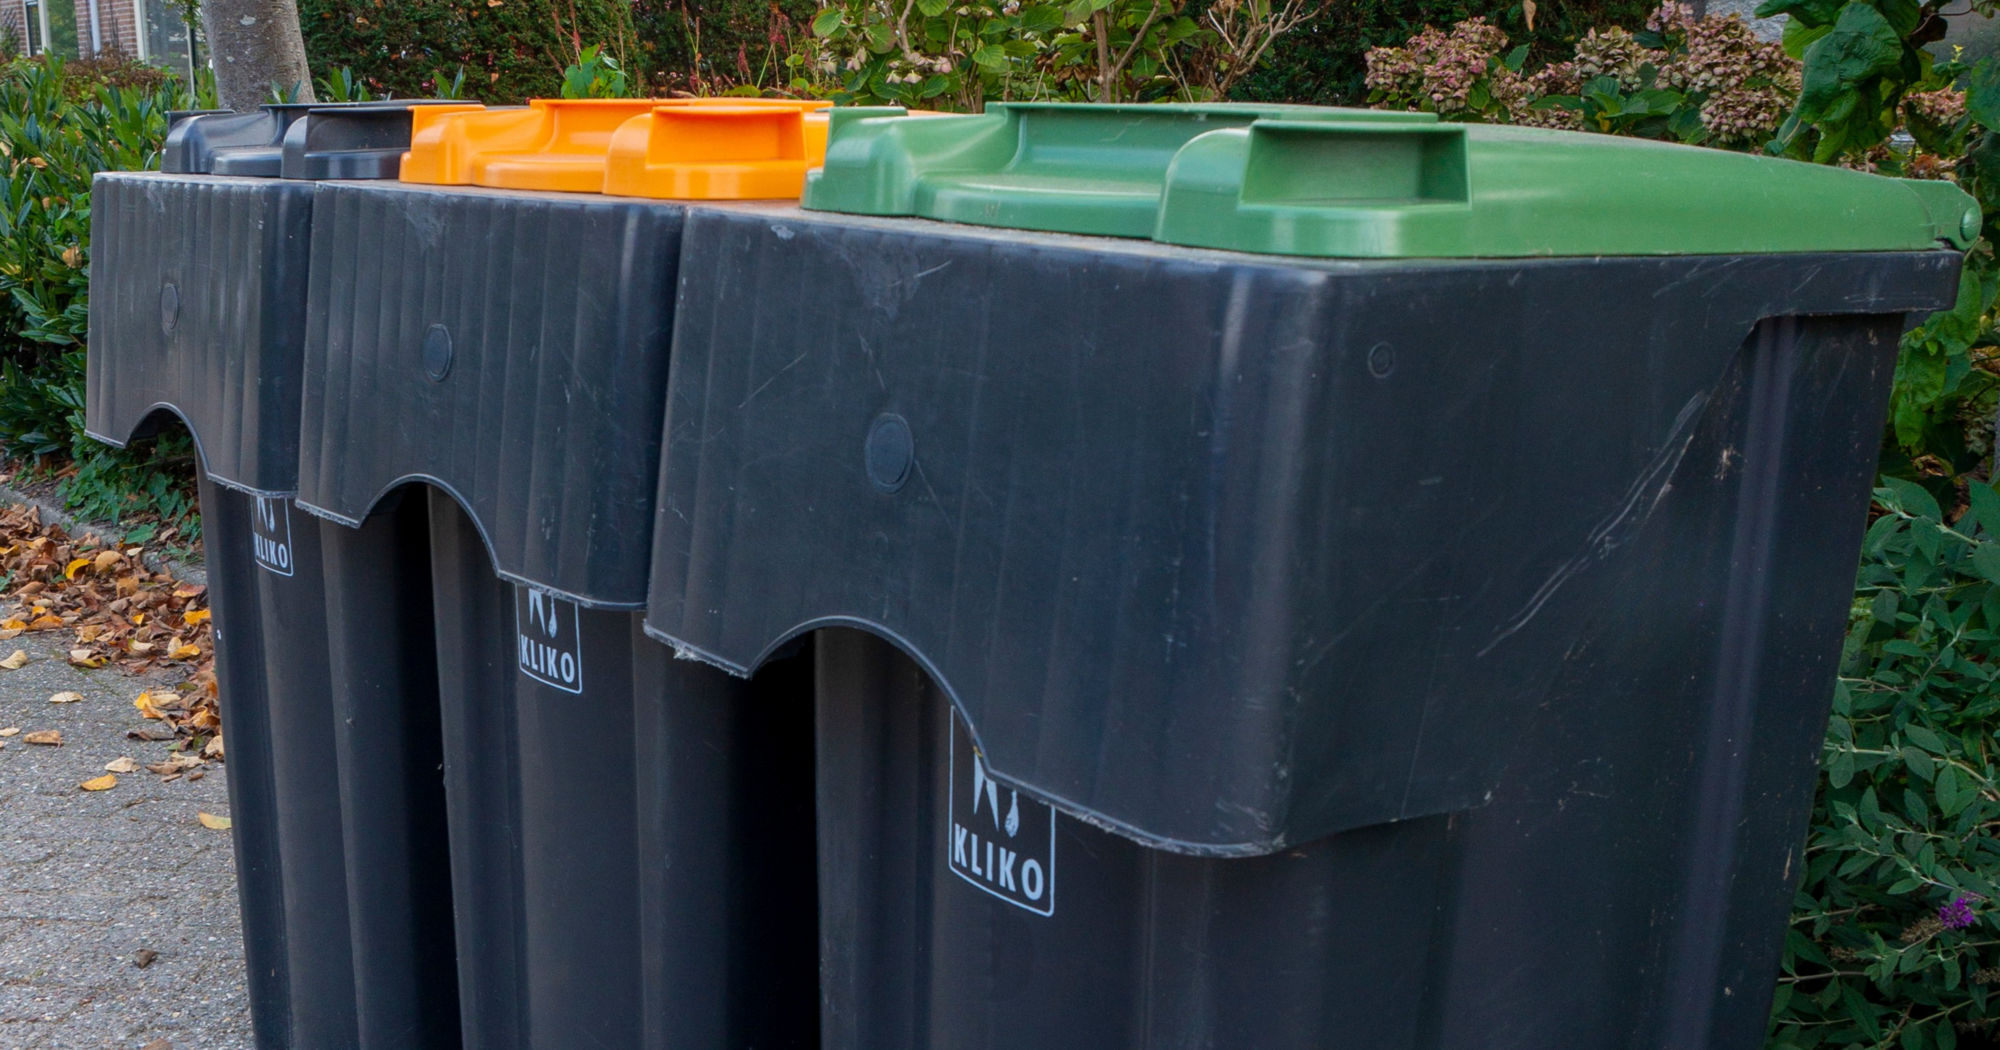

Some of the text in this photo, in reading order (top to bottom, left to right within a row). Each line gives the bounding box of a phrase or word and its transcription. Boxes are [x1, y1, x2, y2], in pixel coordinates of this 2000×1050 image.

[254, 532, 288, 568] KLIKO
[520, 634, 575, 683] KLIKO
[954, 823, 1044, 900] KLIKO
